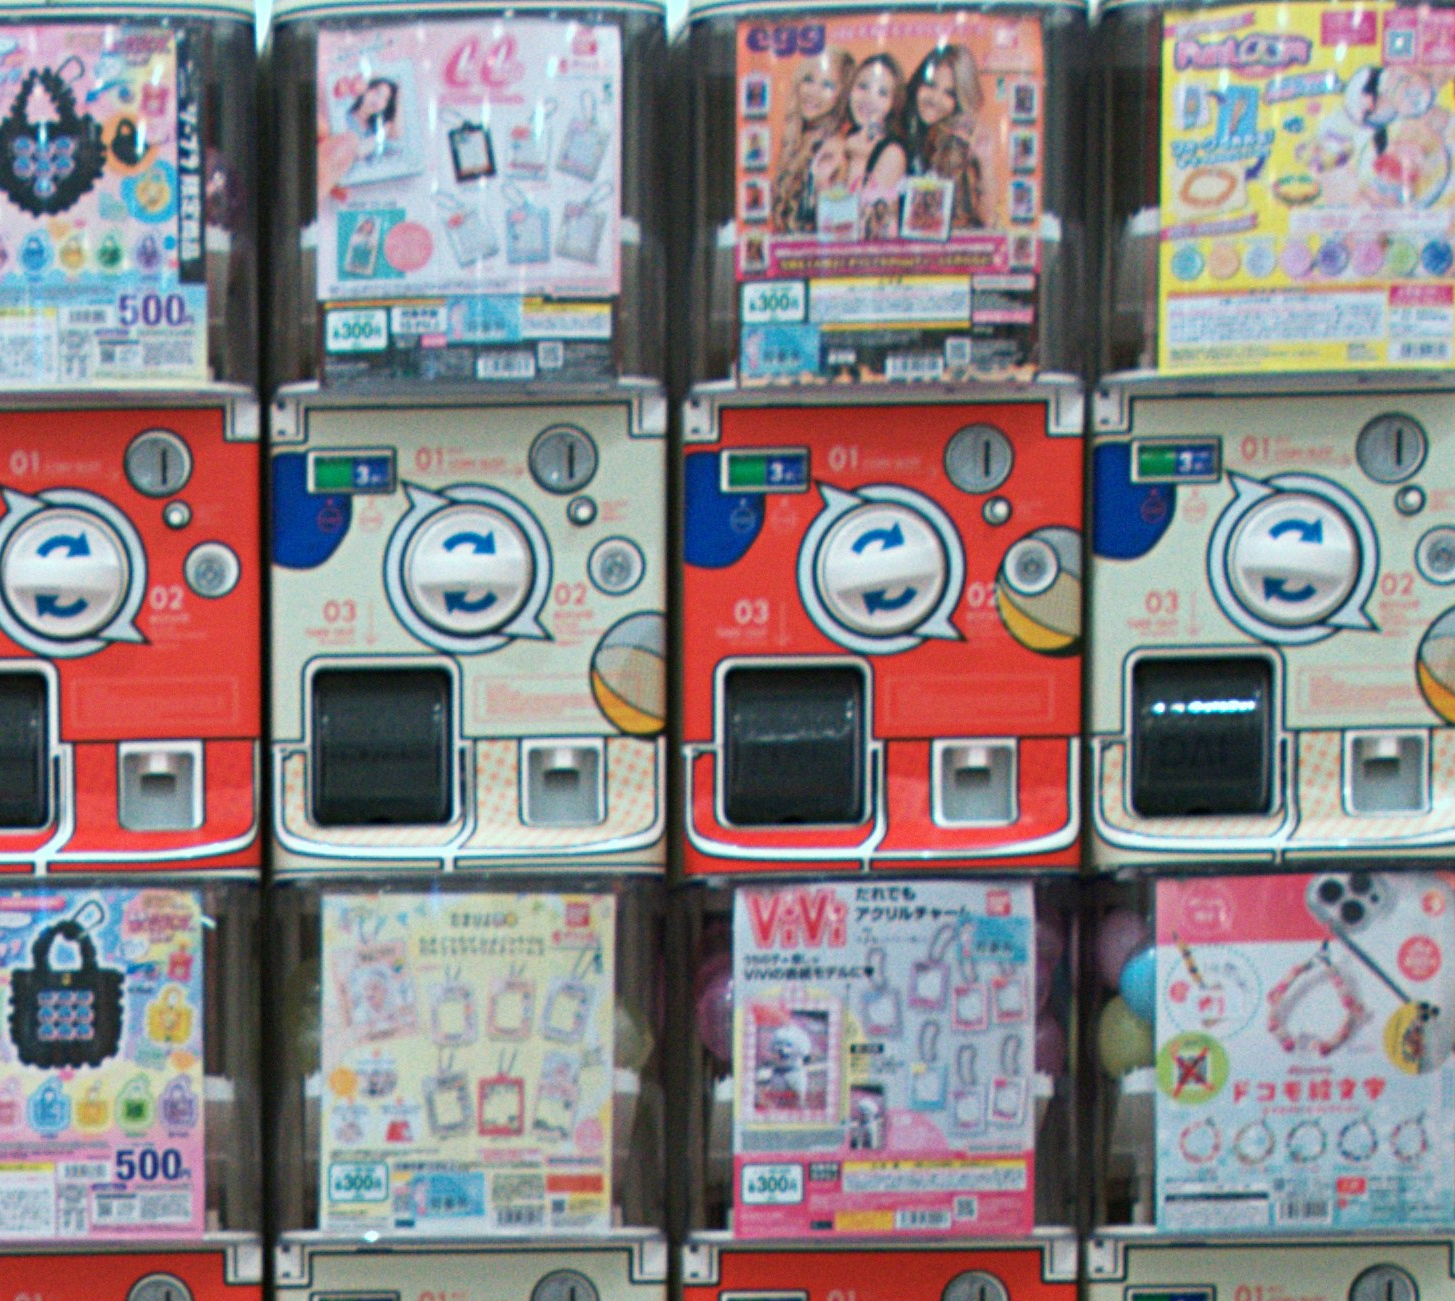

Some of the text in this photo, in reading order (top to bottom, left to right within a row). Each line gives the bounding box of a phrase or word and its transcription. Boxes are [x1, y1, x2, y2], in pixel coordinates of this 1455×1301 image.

[746, 24, 827, 56] egg
[10, 450, 39, 476] 01
[828, 446, 858, 472] 01
[150, 586, 183, 610] 02
[734, 599, 769, 624] 03
[746, 891, 847, 948] ViVi
